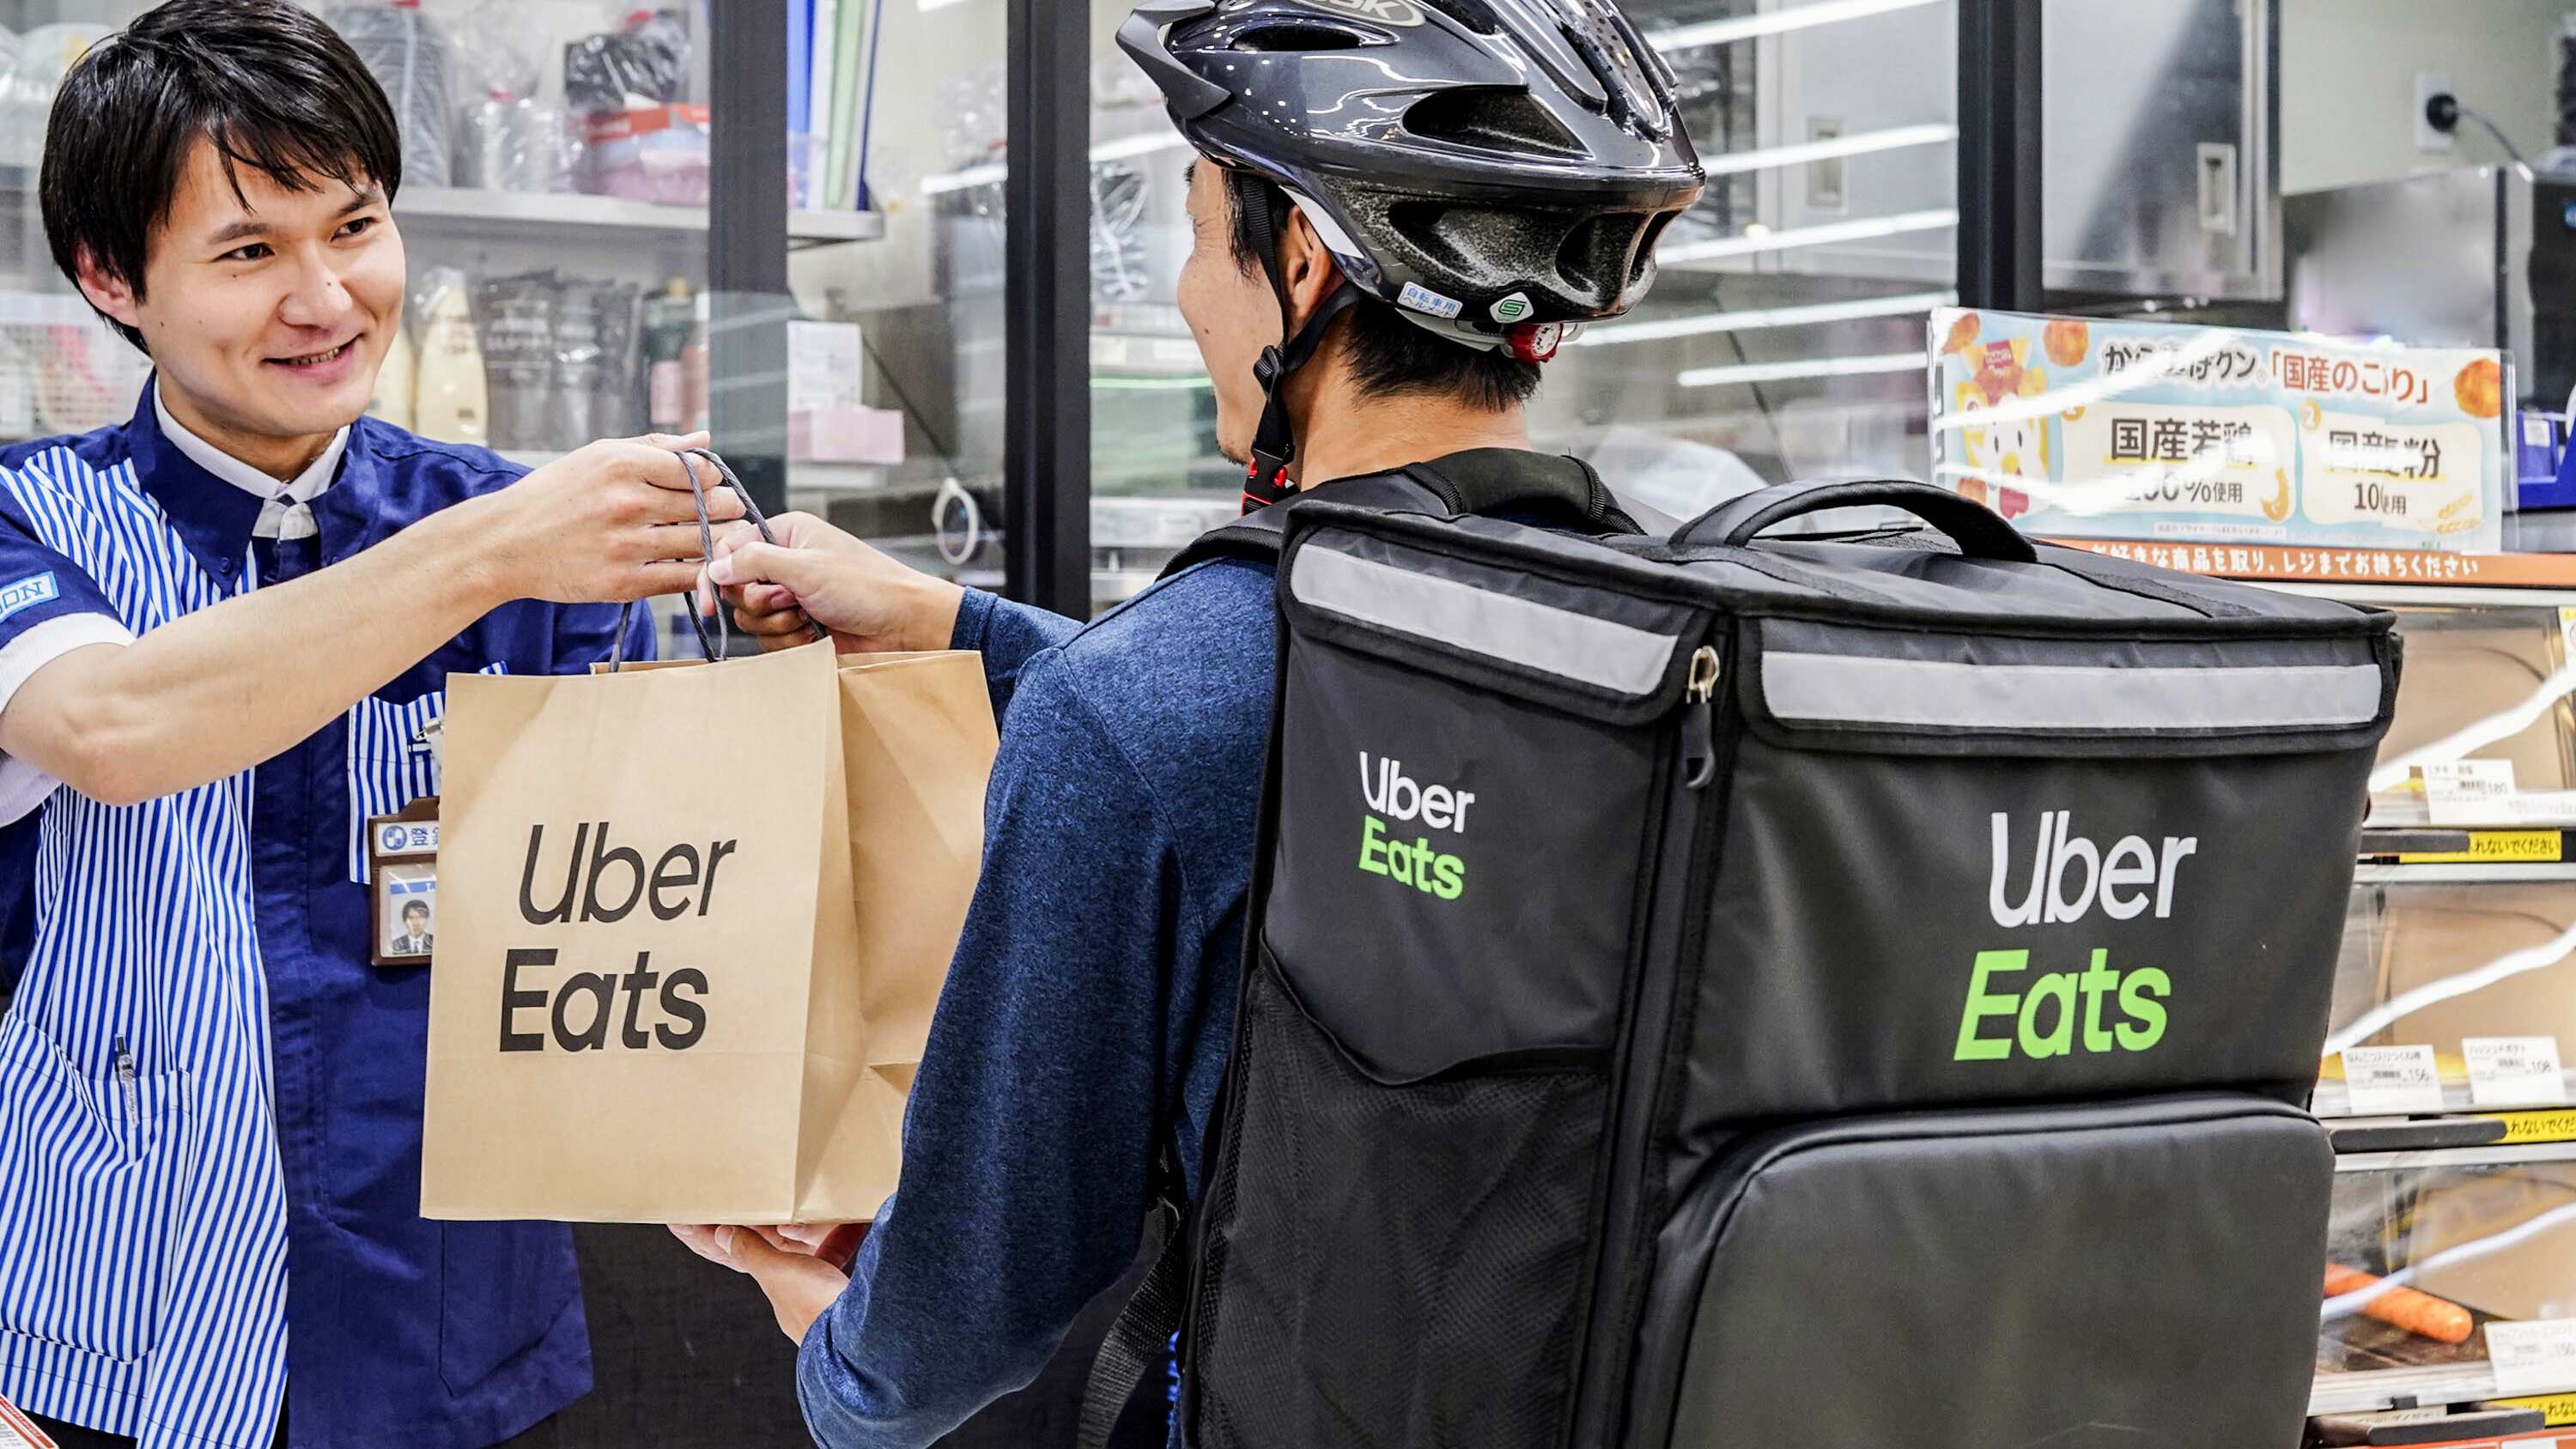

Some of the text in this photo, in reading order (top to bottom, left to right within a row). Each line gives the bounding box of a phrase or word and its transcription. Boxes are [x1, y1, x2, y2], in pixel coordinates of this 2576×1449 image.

[2111, 418, 2255, 465] 国産若
[0, 581, 44, 615] ON
[1359, 751, 1475, 834] Uber
[519, 822, 737, 925] Uber
[1358, 815, 1465, 900] Eats
[1990, 810, 2197, 928] Uber
[500, 949, 708, 1052] Eats
[1953, 948, 2171, 1061] Eats
